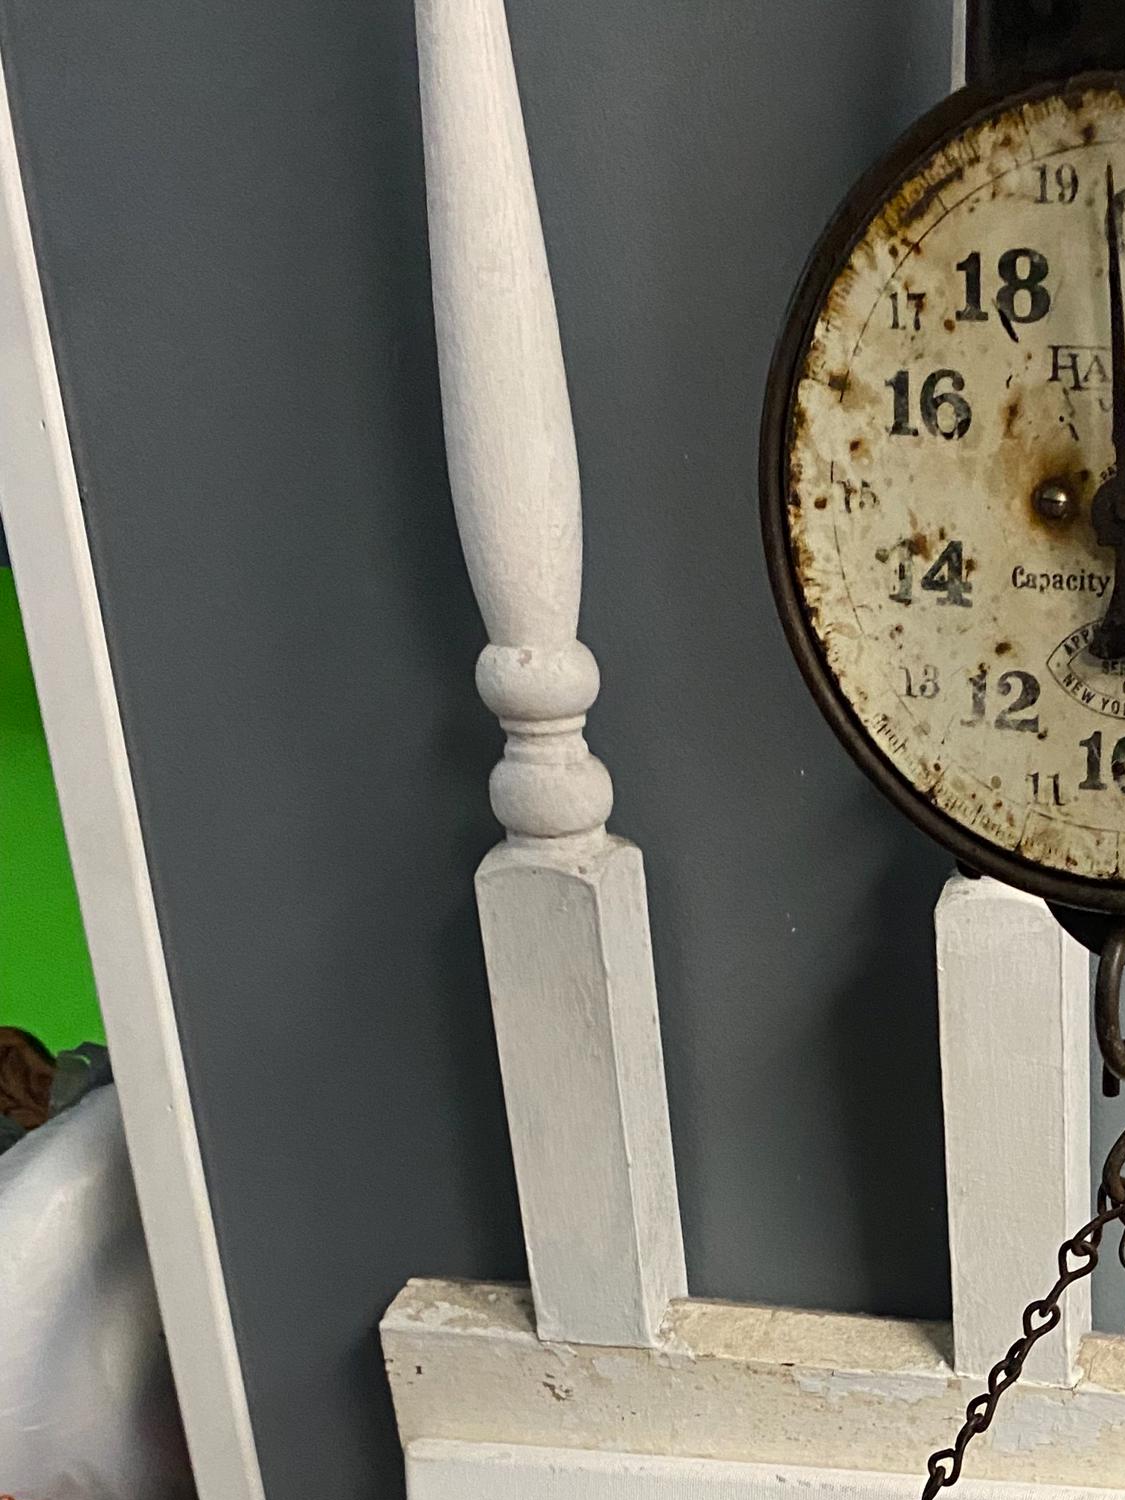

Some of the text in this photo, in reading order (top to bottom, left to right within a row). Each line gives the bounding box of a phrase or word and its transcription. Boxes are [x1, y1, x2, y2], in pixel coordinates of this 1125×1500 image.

[1033, 162, 1080, 205] 19
[955, 247, 1051, 324] 18
[889, 291, 927, 331] 17
[884, 368, 973, 441] 16
[888, 537, 973, 608] 14
[1011, 564, 1112, 598] Capacity
[899, 663, 941, 700] 13
[959, 666, 1041, 734] 12
[1062, 673, 1096, 704] NEW
[1025, 771, 1066, 807] 11
